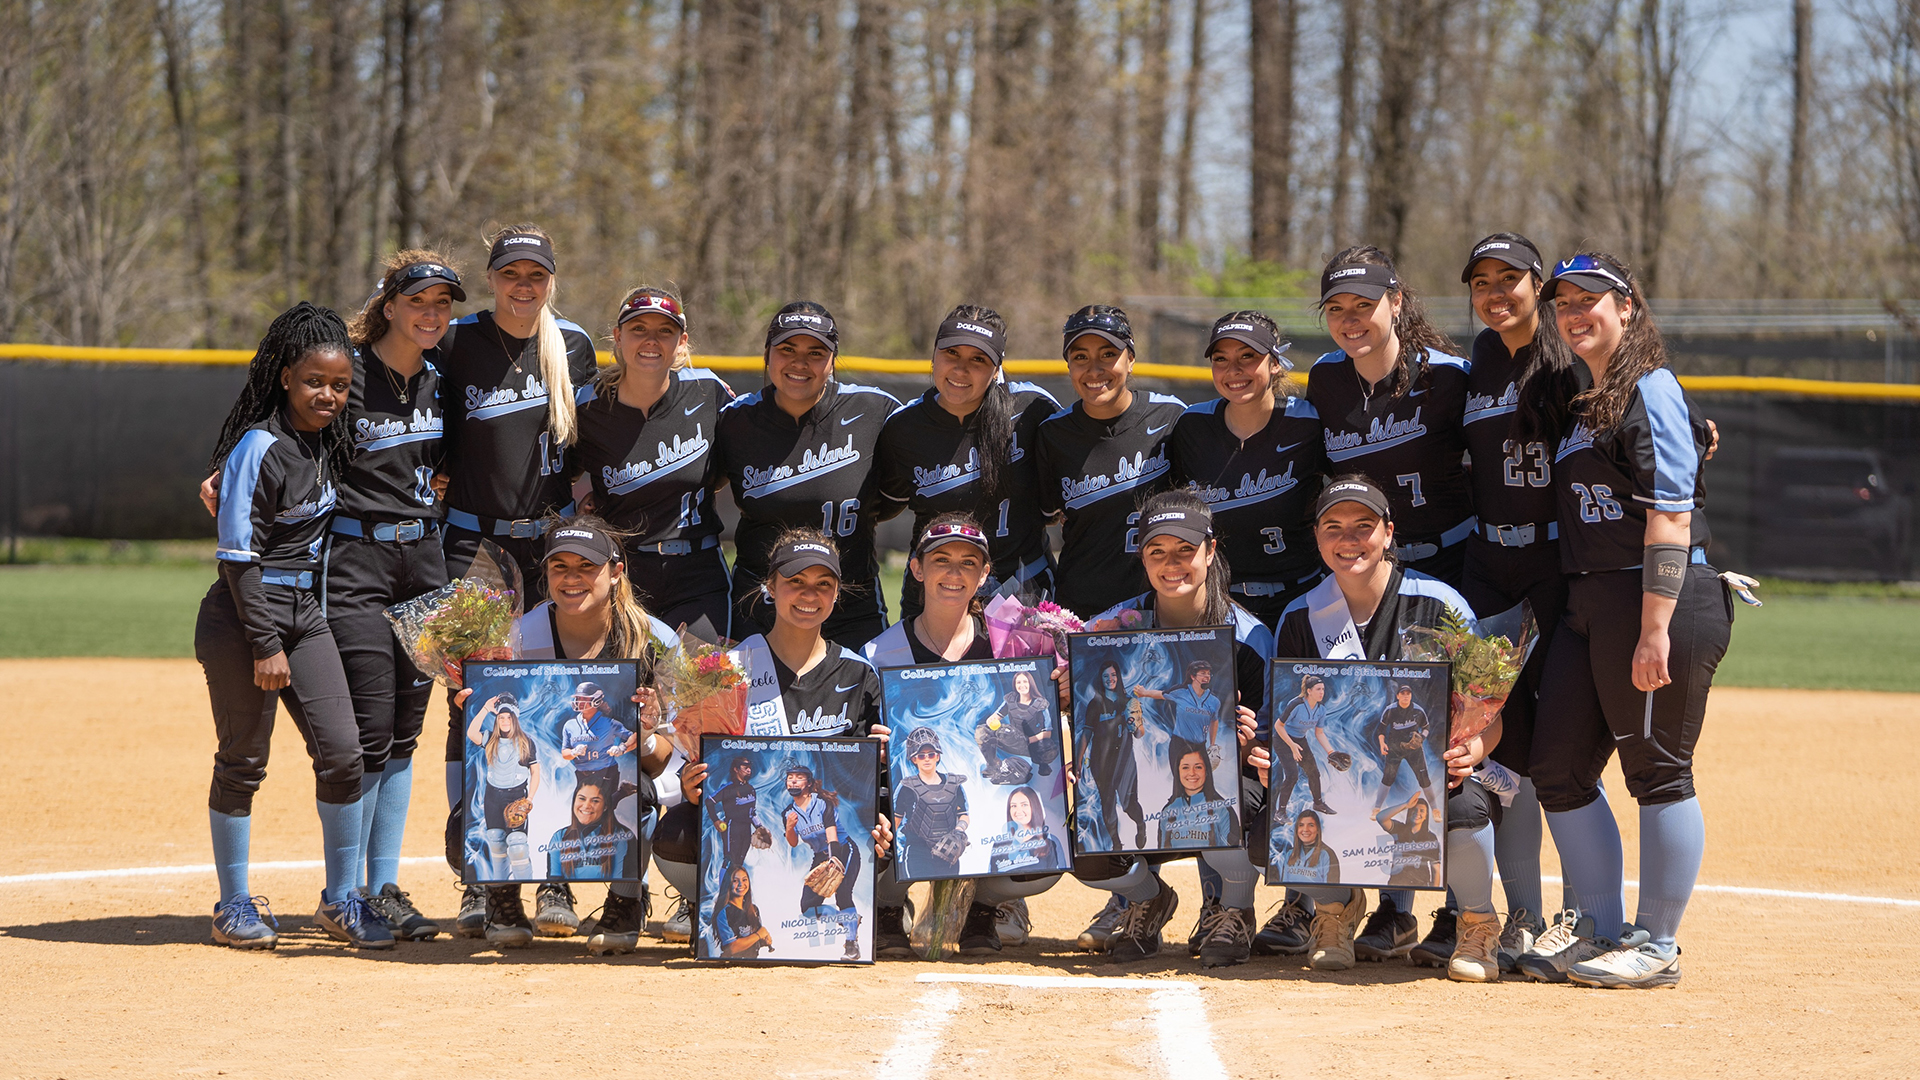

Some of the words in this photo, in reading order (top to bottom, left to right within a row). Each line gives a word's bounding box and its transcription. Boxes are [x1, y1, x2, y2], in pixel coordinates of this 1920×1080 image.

[504, 237, 541, 247] DOLPHINS
[1474, 242, 1510, 256] DOLPHINS
[1329, 268, 1367, 280] DOLPHINS
[957, 322, 993, 337] DOLPHINS
[1217, 323, 1254, 333] DOLPHINS
[465, 385, 518, 411] Staten
[355, 417, 406, 442] Staten
[1323, 427, 1362, 451] Staten
[1365, 406, 1427, 444] Island
[539, 431, 566, 476] 13
[602, 460, 652, 489] Staten
[655, 422, 708, 467] Island
[742, 465, 794, 490] Staten
[797, 433, 860, 472] Island
[1061, 473, 1110, 501] Staten
[1114, 442, 1171, 483] Island
[1502, 438, 1551, 489] 23
[913, 462, 960, 488] Staten
[1235, 461, 1298, 499] Island
[1330, 483, 1368, 495] DOLPHINS
[1396, 472, 1427, 508] 7
[677, 487, 705, 529] 11
[1570, 482, 1624, 524] 26
[821, 497, 861, 538] 16
[996, 498, 1010, 538] 1
[1148, 512, 1185, 524] DOLPHINS
[555, 530, 593, 540] DOLPHINS
[1260, 526, 1287, 555] 3
[793, 543, 830, 555] DOLPHINS
[1087, 635, 1130, 648] College
[1131, 634, 1143, 644] of
[1144, 632, 1178, 643] Staten
[1180, 630, 1216, 641] Island
[1321, 630, 1354, 651] Sam
[483, 667, 528, 679] College
[530, 666, 543, 676] of
[544, 665, 580, 675] Staten
[582, 664, 620, 675] Island
[750, 671, 777, 689] cole
[901, 669, 946, 680] College
[948, 667, 960, 676] of
[961, 665, 997, 675] Staten
[999, 662, 1036, 673] Island
[1293, 664, 1339, 677] College
[1340, 667, 1353, 676] of
[1354, 666, 1391, 677] Staten
[1393, 668, 1431, 678] Island
[791, 702, 853, 734] Island
[721, 739, 767, 752] College
[769, 741, 783, 751] of
[783, 741, 820, 751] Staten
[821, 742, 860, 752] Island
[1144, 808, 1178, 822] JACLYN
[1182, 797, 1237, 815] KATERIDGE
[1166, 814, 1219, 829] 2019-2022
[538, 840, 581, 853] CLAUDIA
[585, 831, 634, 846] PORCARO
[981, 832, 1013, 846] ISABEL
[1017, 825, 1050, 838] GALLO
[561, 847, 616, 861] 2019-2022
[1342, 848, 1364, 858] SAM
[1367, 840, 1438, 856] MACPHERSON
[1364, 856, 1421, 869] 2019-2022
[781, 917, 817, 929] NICOLE
[820, 913, 858, 925] RIVERA
[793, 927, 849, 940] 2020-2022
